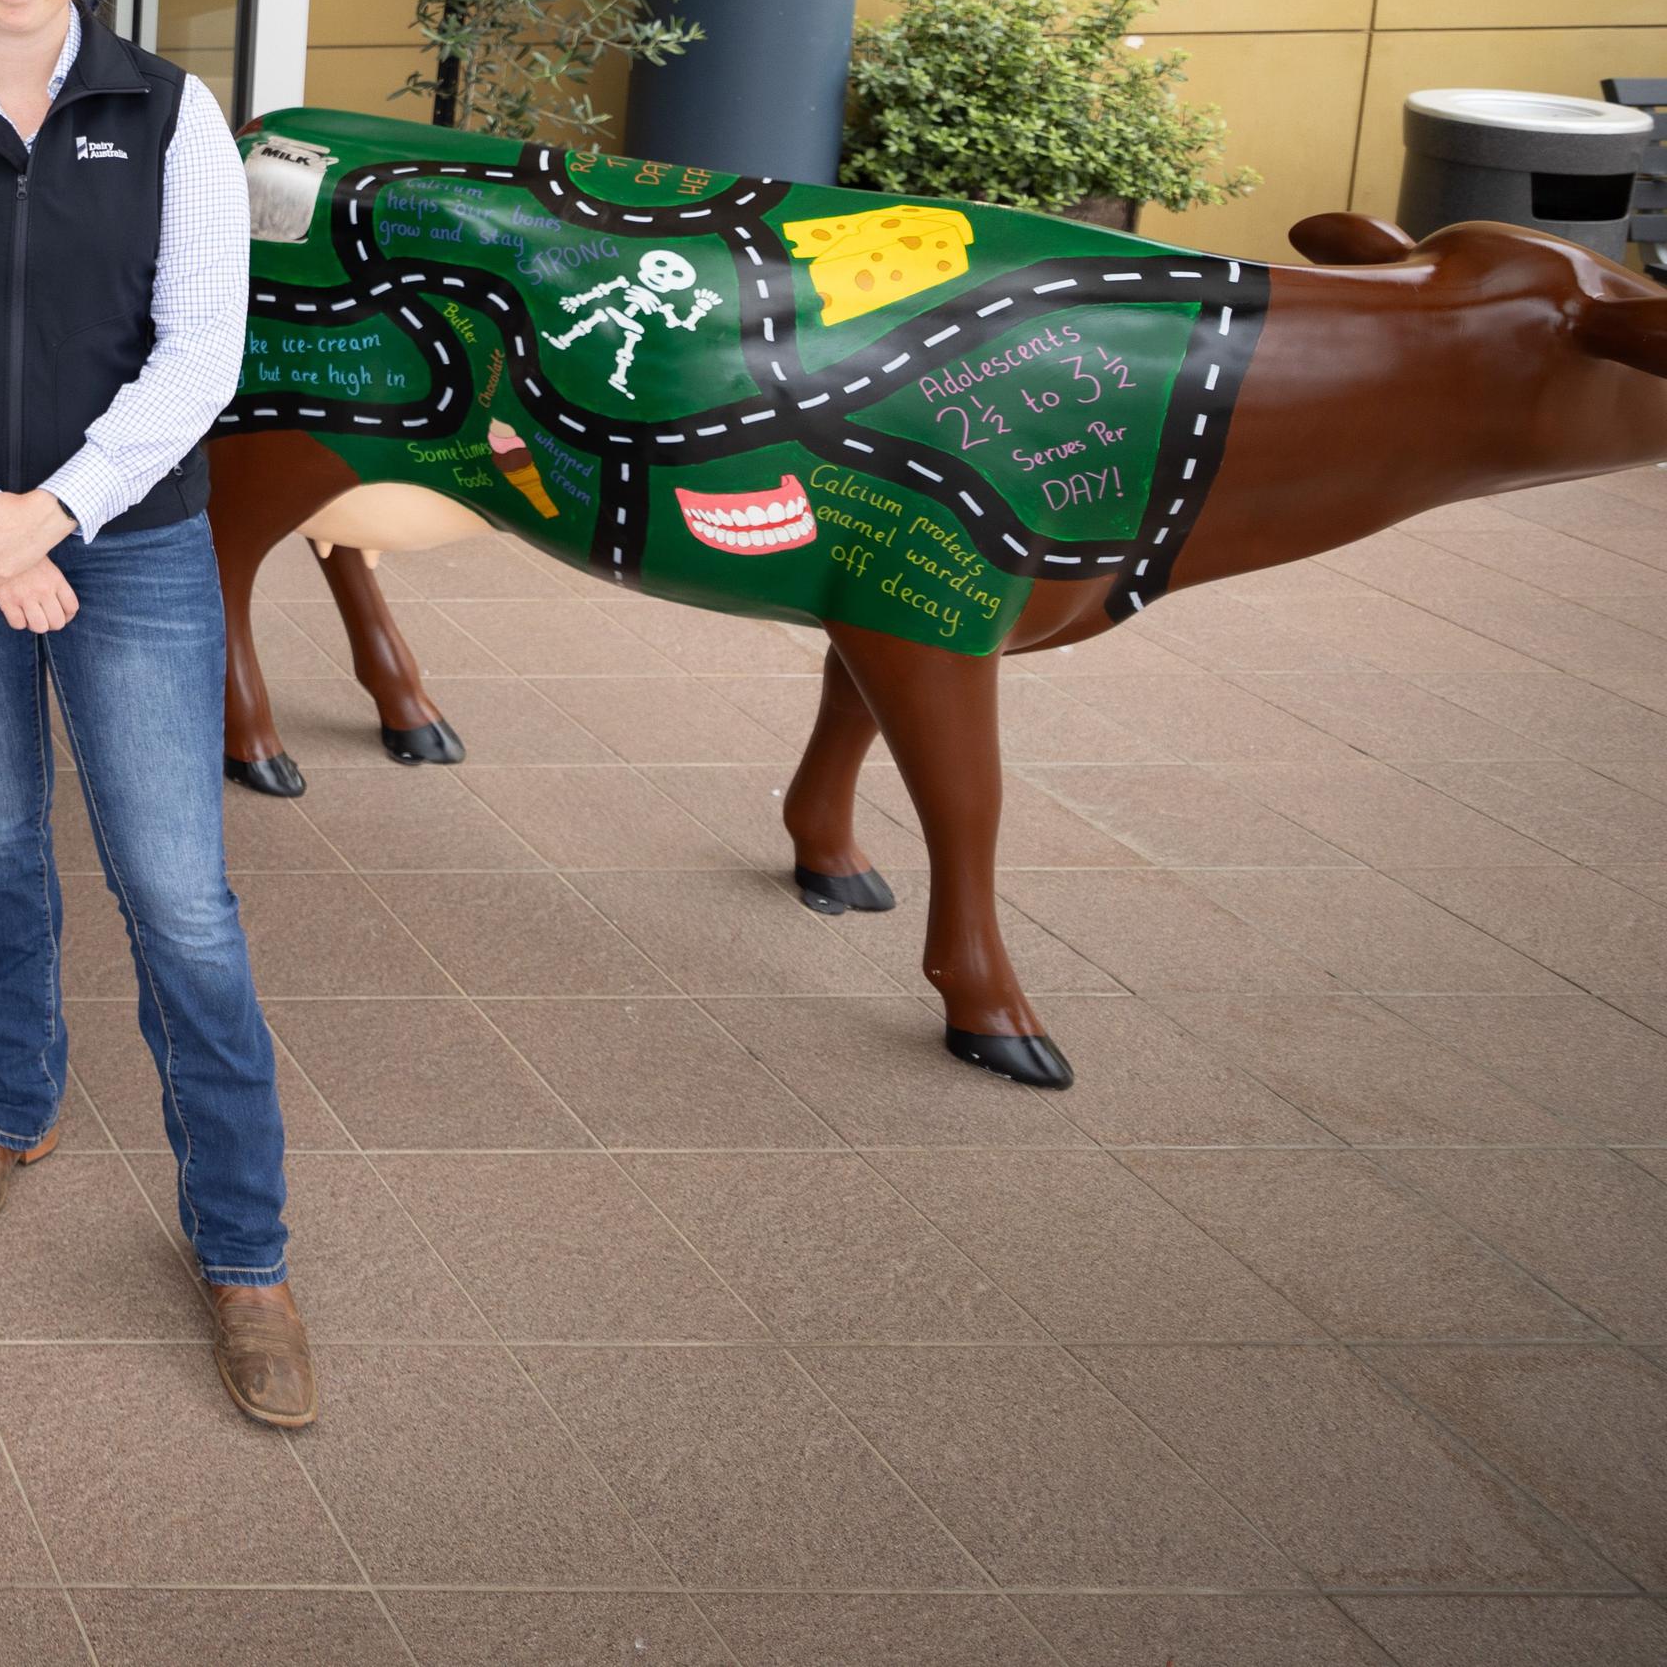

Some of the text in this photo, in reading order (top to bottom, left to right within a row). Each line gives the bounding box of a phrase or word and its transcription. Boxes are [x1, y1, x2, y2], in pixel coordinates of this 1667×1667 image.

[88, 141, 114, 151] Dairy
[90, 149, 128, 159] Australia
[260, 146, 312, 167] MILK
[635, 160, 674, 185] DA
[387, 189, 563, 233] helps our bones
[379, 220, 525, 259] grow and stay
[517, 237, 620, 286] STRONG
[243, 329, 382, 354] ke ice-cream
[443, 302, 478, 344] Butter
[259, 361, 281, 382] but
[291, 369, 319, 385] are
[327, 363, 373, 396] high
[387, 369, 407, 388] in
[478, 347, 507, 409] Chocolate
[919, 325, 1081, 403] Adolescents
[1021, 388, 1060, 413] to
[407, 440, 493, 463] Sometimes
[534, 432, 595, 478] whipped
[1012, 421, 1128, 471] Serves Per
[452, 466, 494, 488] Foods
[549, 470, 592, 507] cream
[1041, 465, 1124, 511] DAY!
[810, 463, 986, 577] Calcium protects
[817, 505, 1002, 620] enamel warding
[830, 544, 874, 578] off
